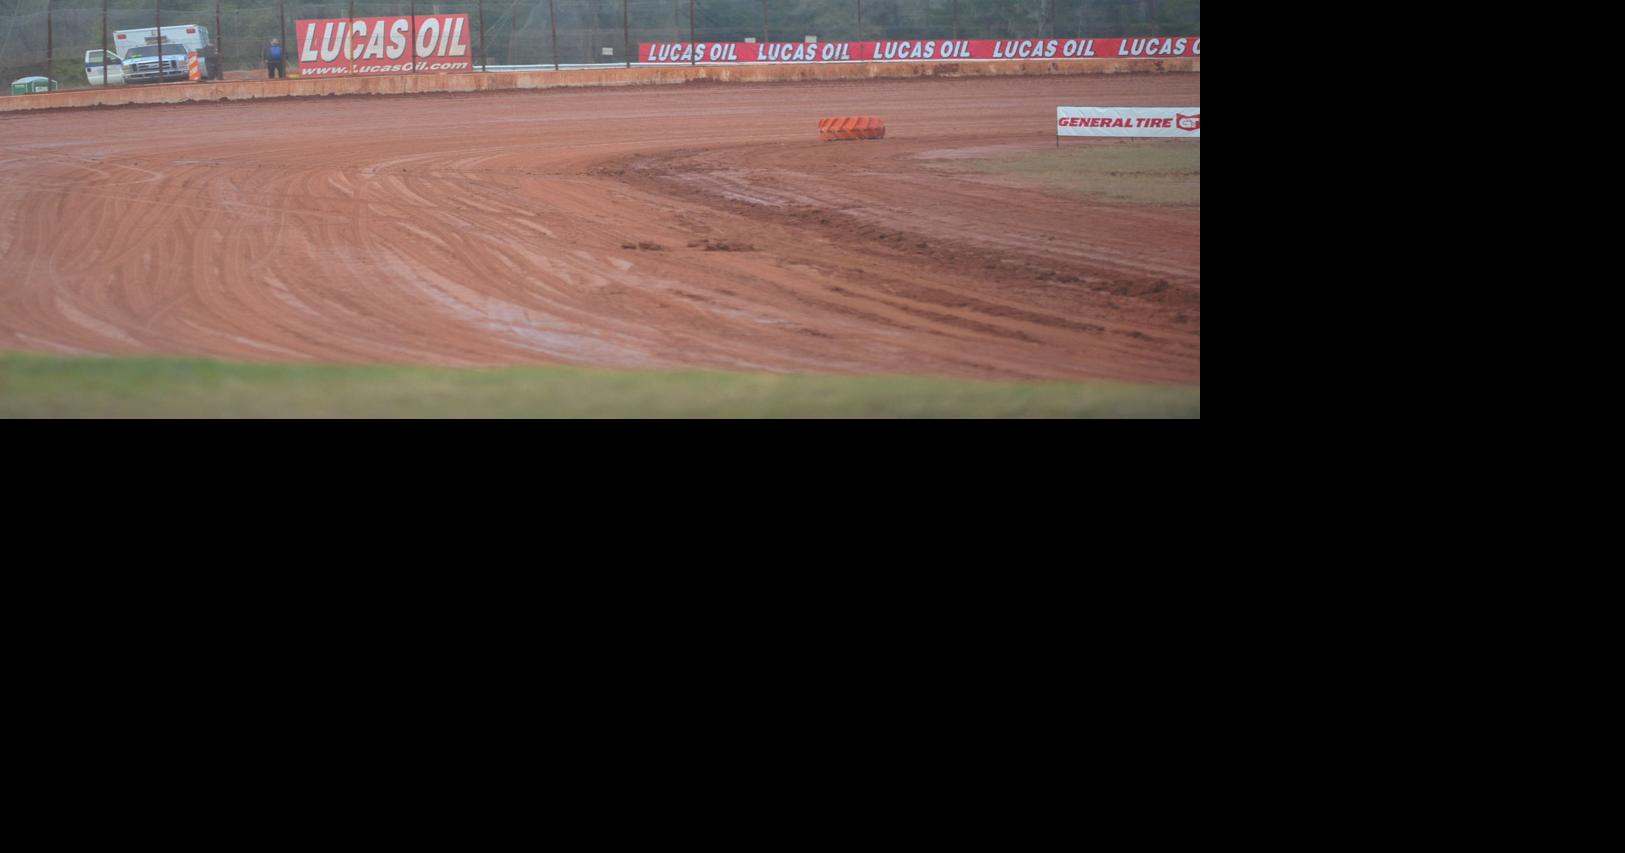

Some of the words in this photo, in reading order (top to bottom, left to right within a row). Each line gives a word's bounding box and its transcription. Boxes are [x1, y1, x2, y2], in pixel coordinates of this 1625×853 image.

[301, 19, 409, 62] LUCAS
[415, 17, 467, 58] OIL
[992, 39, 1058, 58] LUCAS
[1062, 38, 1095, 57] OIL
[1118, 38, 1187, 56] LUCAS
[648, 43, 706, 61] LUCAS
[710, 42, 738, 60] OIL
[757, 42, 818, 60] LUCAS
[822, 42, 850, 60] OIL
[873, 41, 935, 59] LUCAS
[940, 40, 970, 58] OIL
[1058, 117, 1133, 128] GENERAL
[1136, 117, 1173, 128] TIRE
